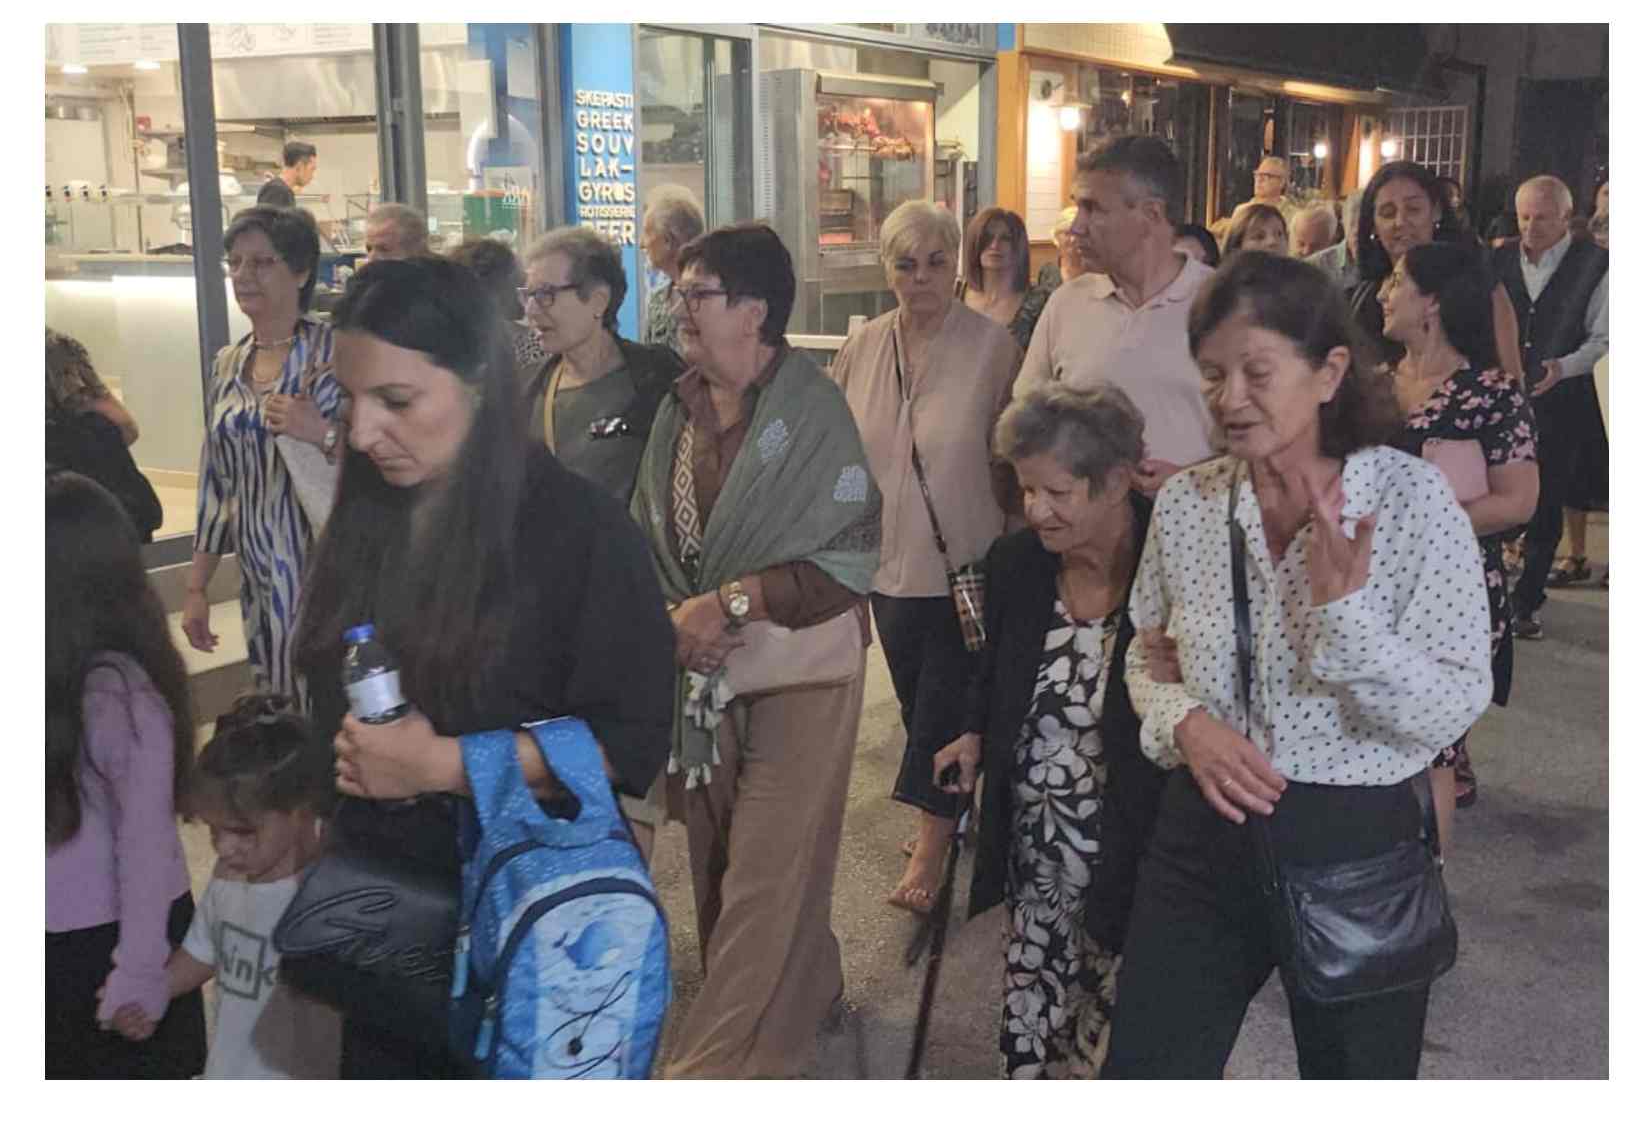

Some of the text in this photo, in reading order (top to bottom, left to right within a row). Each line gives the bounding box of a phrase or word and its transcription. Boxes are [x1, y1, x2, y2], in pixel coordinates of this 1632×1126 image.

[576, 110, 634, 131] GREEK
[576, 134, 634, 155] SOUV
[579, 182, 635, 203] GYROS
